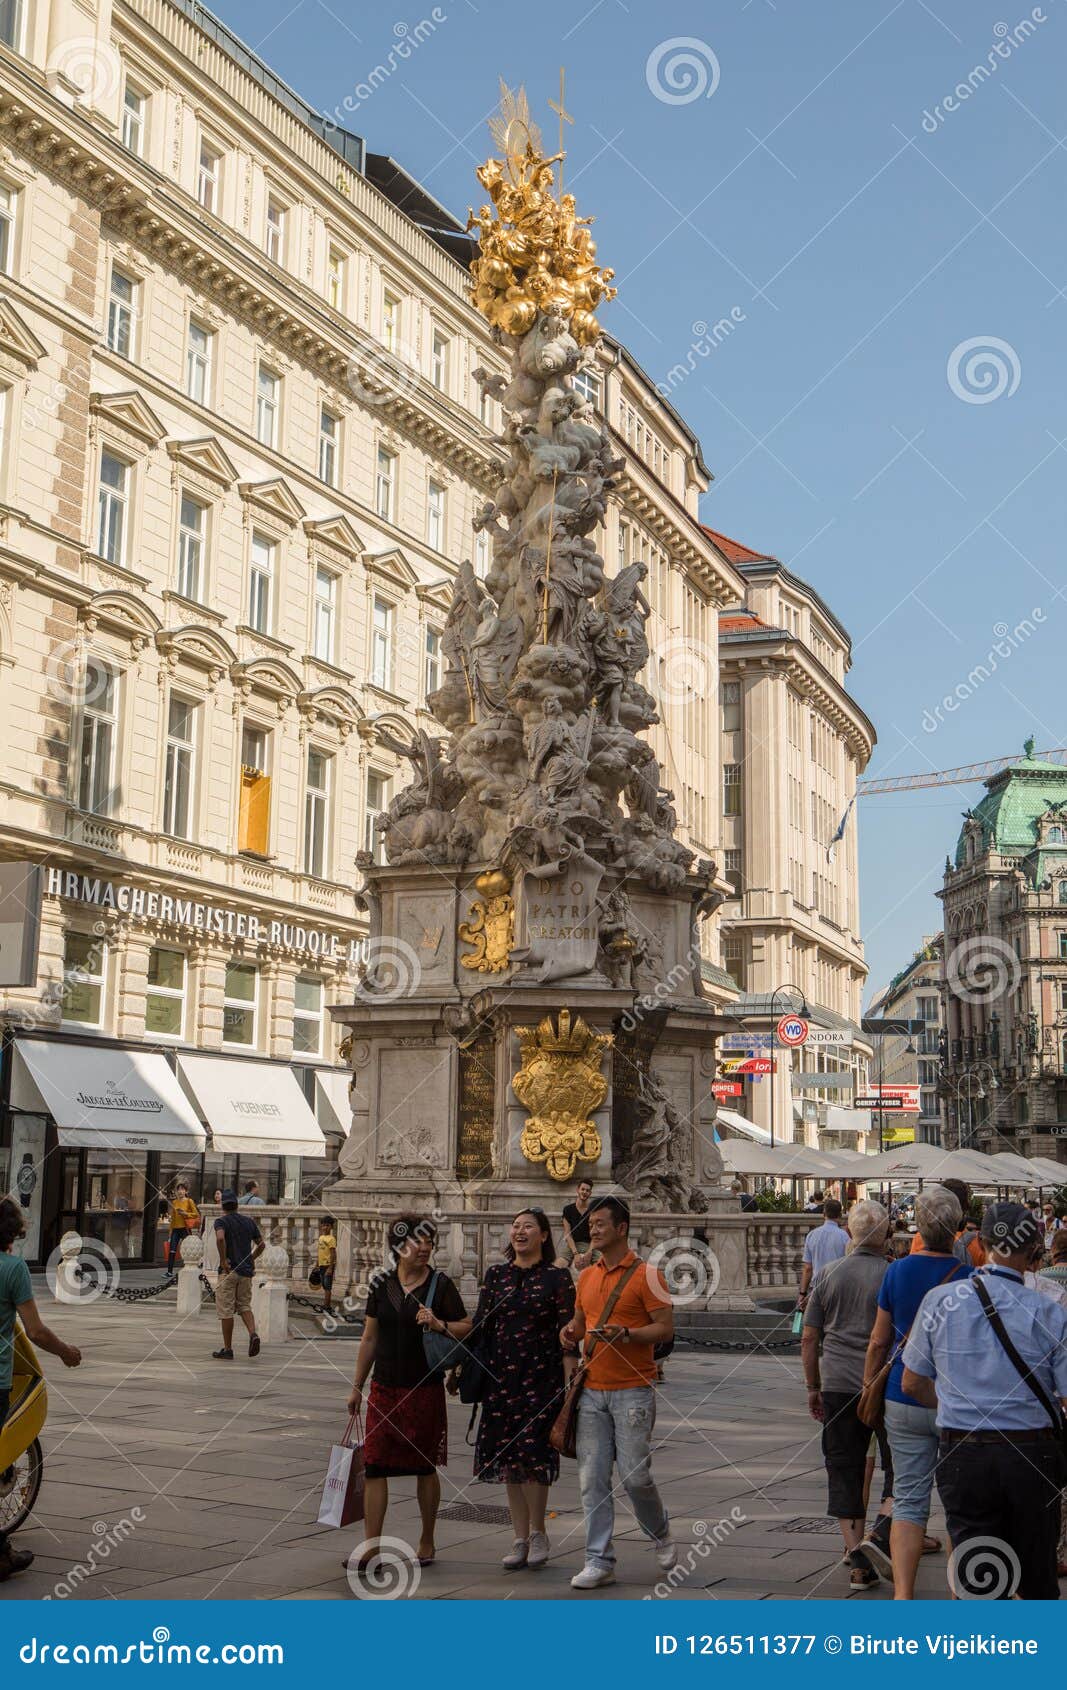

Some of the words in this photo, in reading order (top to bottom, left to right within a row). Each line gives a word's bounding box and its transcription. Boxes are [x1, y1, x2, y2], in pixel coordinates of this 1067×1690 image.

[537, 880, 585, 896] DEO
[531, 904, 591, 918] PATRI
[531, 926, 597, 940] CREATORI
[807, 1033, 845, 1042] NDORA
